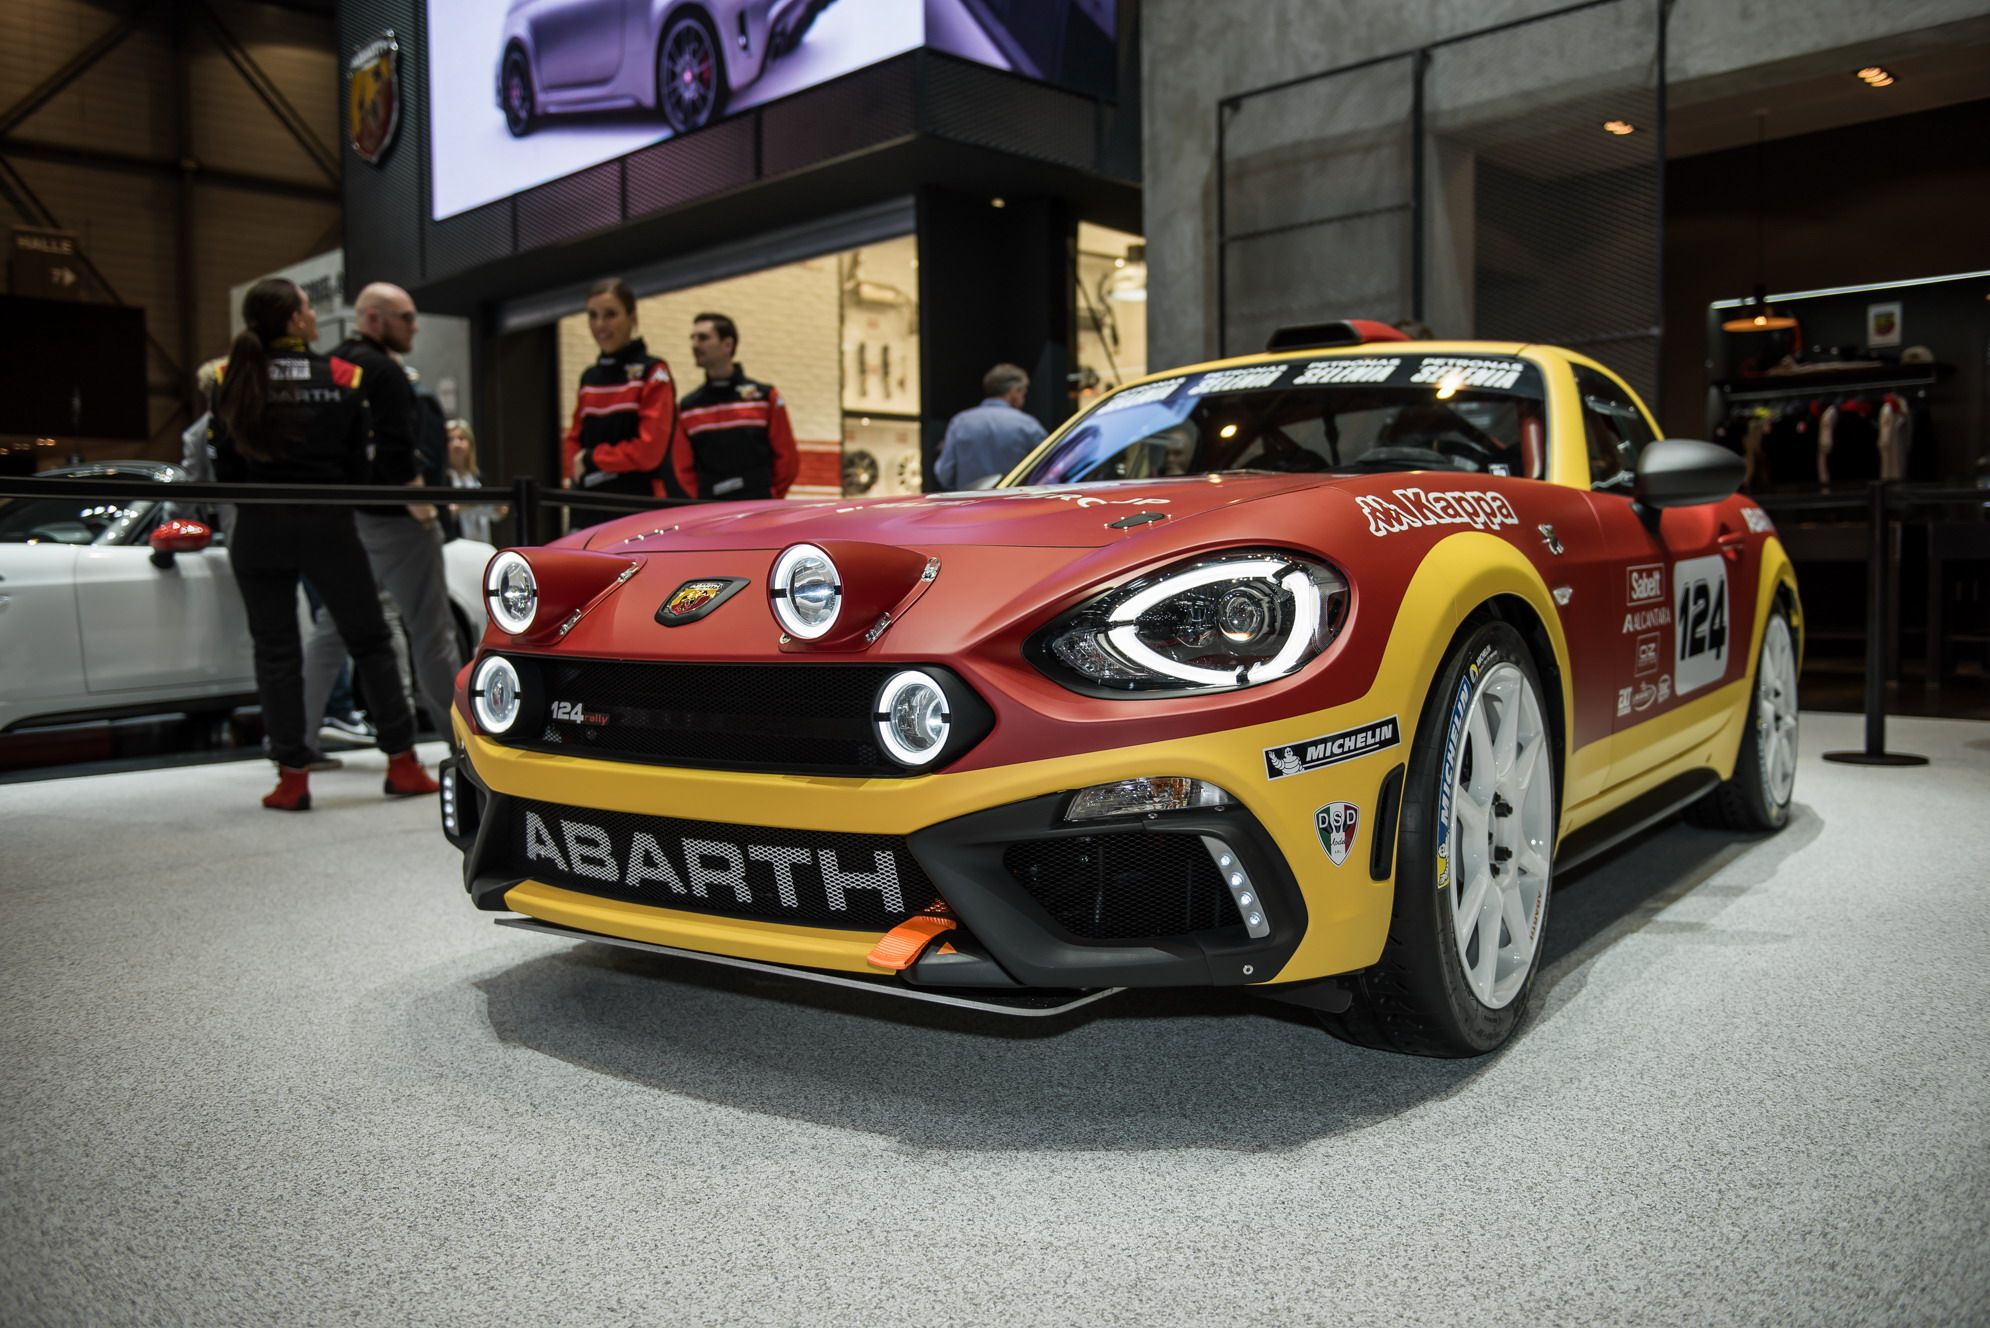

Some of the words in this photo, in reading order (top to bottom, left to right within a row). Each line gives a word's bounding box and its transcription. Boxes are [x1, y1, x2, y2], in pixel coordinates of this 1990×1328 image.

[1307, 357, 1402, 369] PETRONAS
[1422, 357, 1524, 371] PETRONAS
[1392, 487, 1520, 530] Kappa
[1678, 576, 1727, 662] 124
[551, 701, 584, 724] 124
[584, 713, 609, 726] rally
[1305, 724, 1393, 762] MICHELIN
[1441, 684, 1470, 826] MICHELIN
[1318, 809, 1356, 829] DSD
[526, 811, 904, 913] ABARTH
